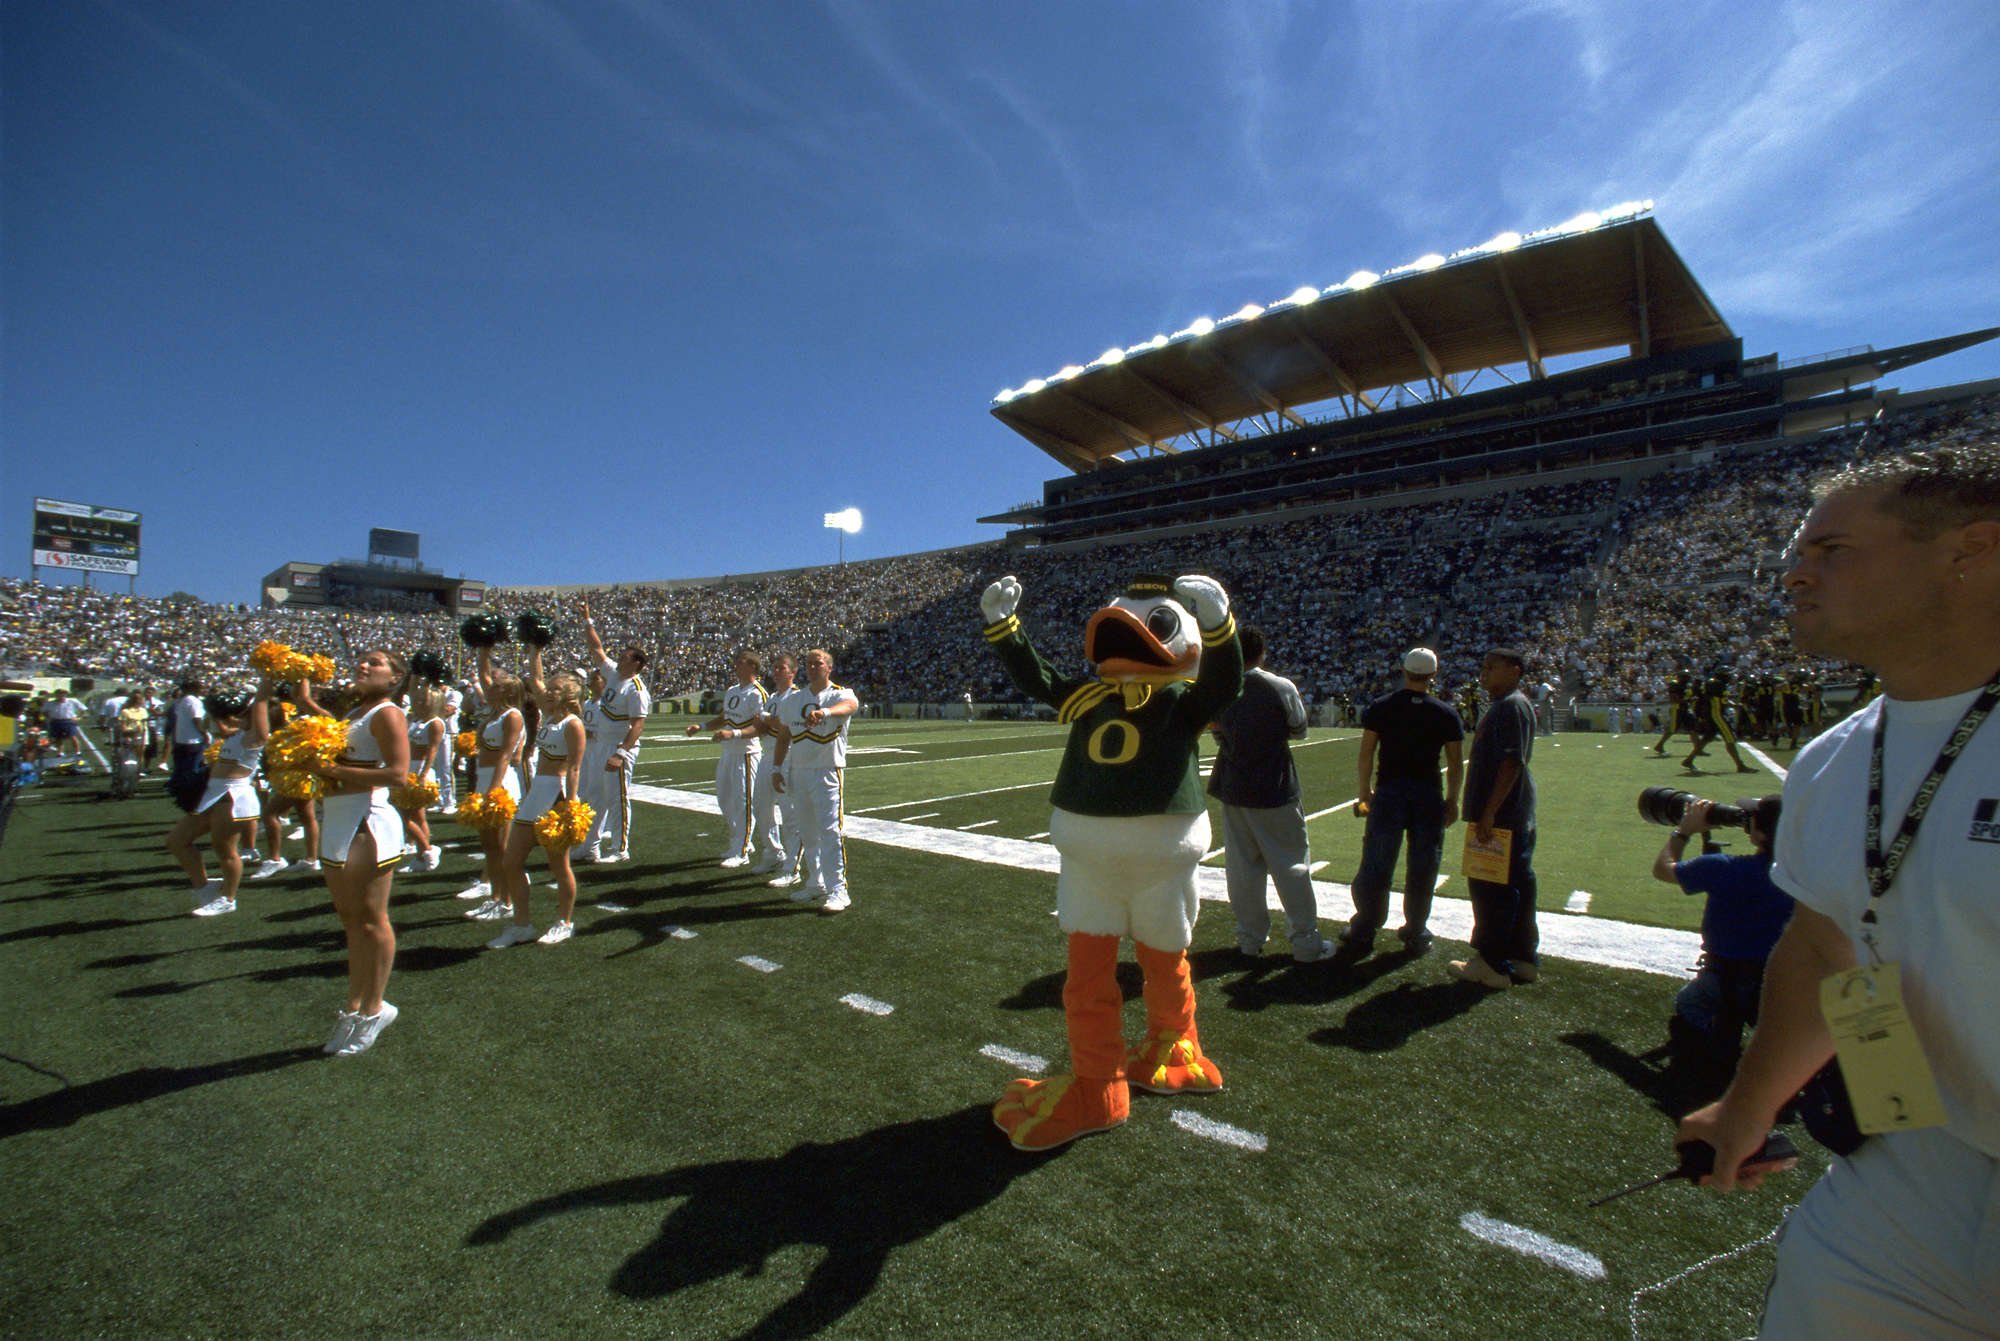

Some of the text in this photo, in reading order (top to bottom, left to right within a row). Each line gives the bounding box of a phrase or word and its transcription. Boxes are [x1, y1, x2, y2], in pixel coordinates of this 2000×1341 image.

[71, 554, 129, 567] SAFEWAY
[1088, 720, 1140, 764] O
[1970, 822, 2000, 838] SPO
